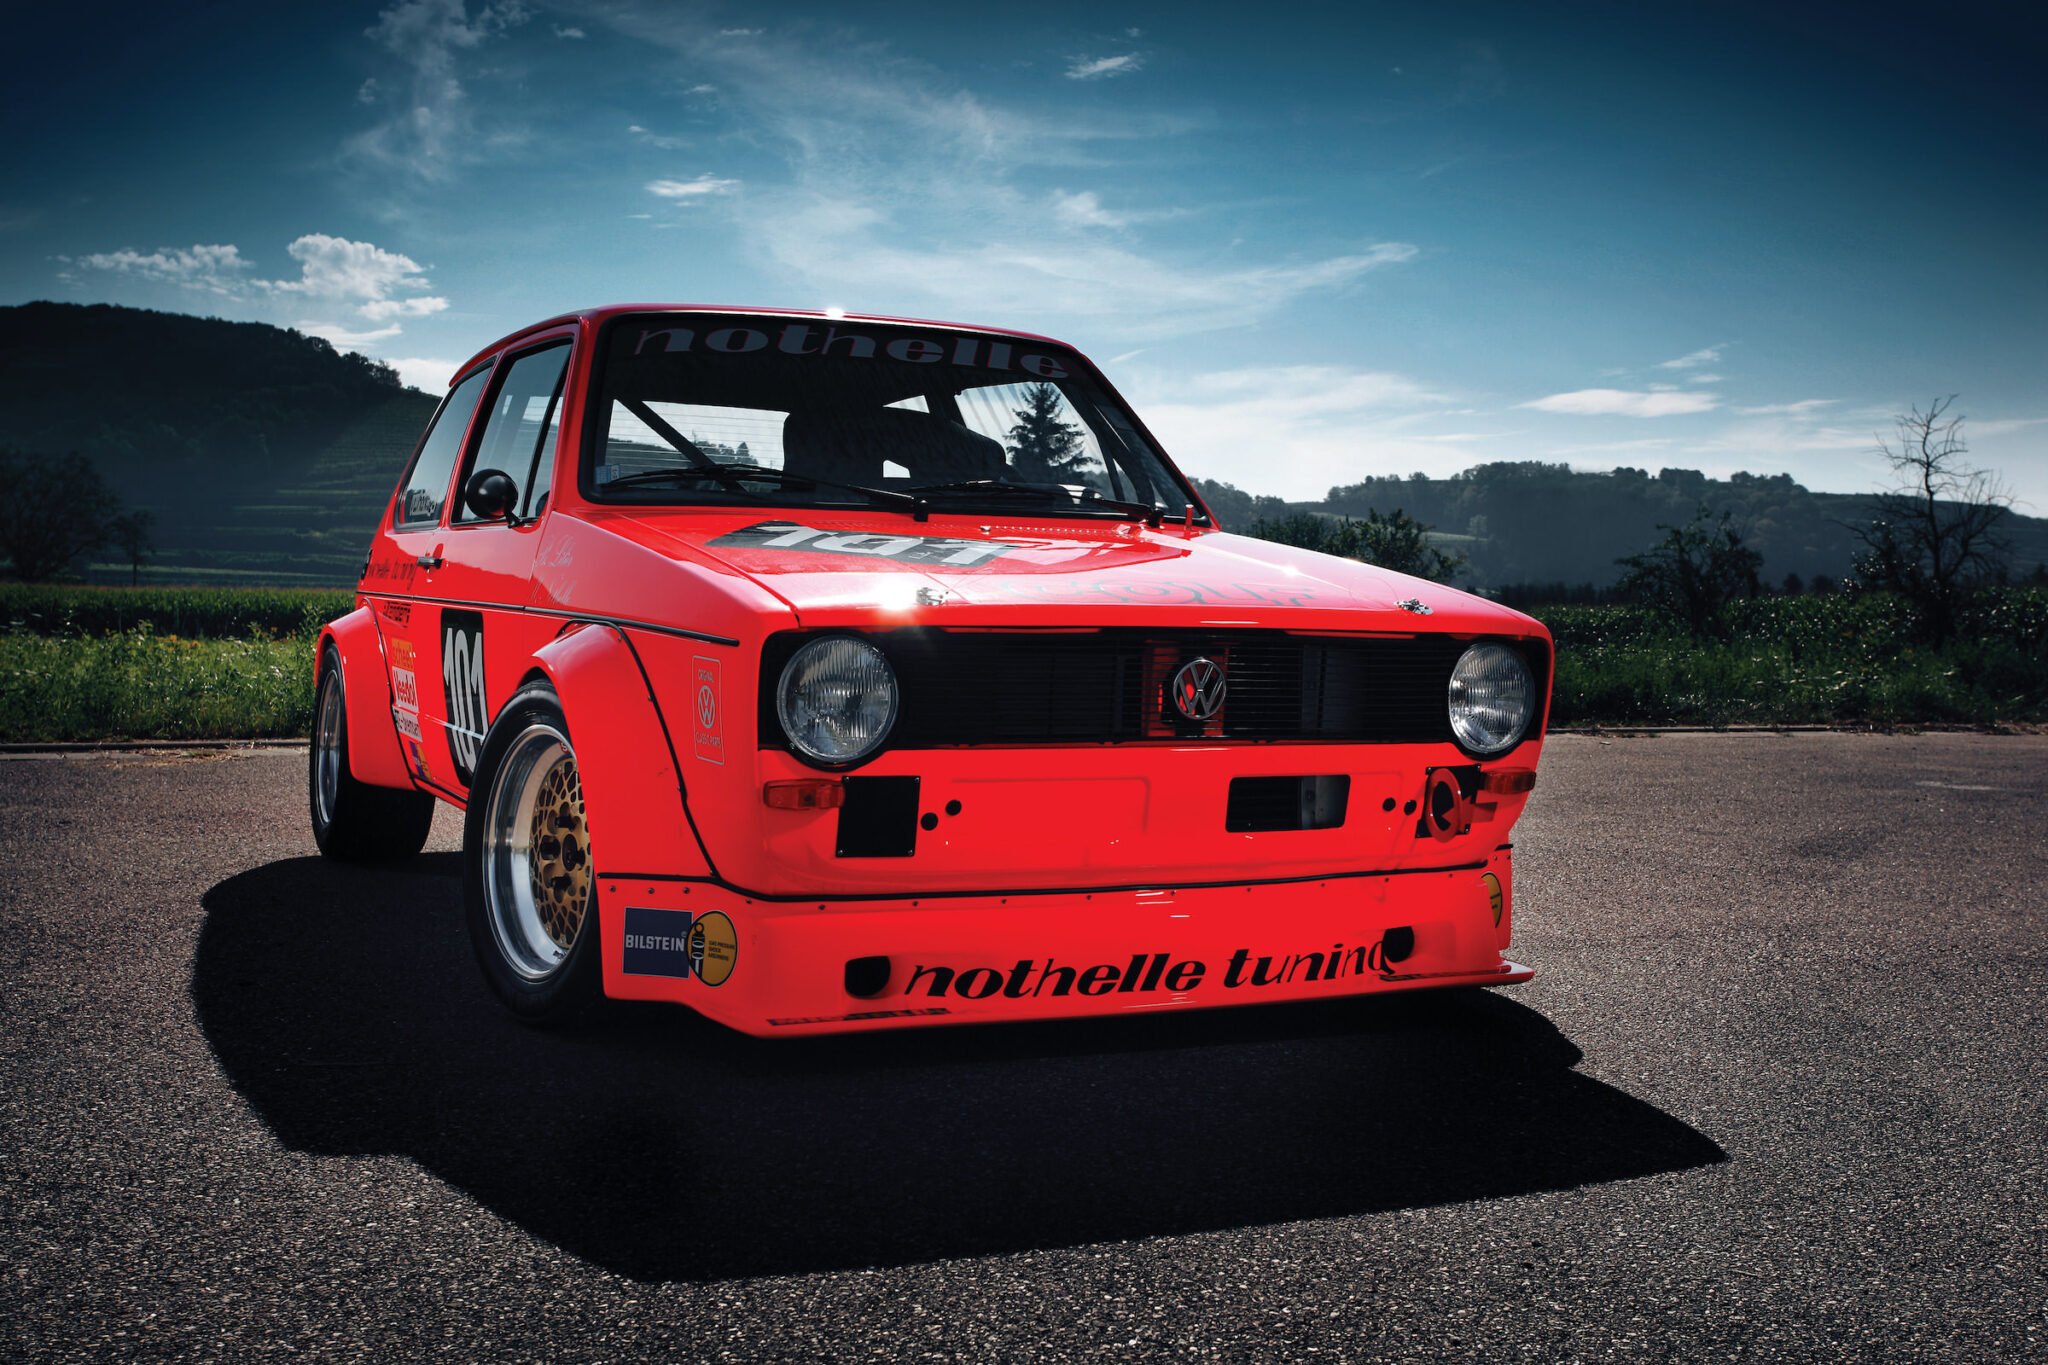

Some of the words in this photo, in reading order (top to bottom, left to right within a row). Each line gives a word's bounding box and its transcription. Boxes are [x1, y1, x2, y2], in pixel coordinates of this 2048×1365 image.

[634, 323, 1069, 380] nothelle
[756, 526, 1006, 565] 101
[443, 627, 489, 777] 101
[625, 934, 685, 951] BILSTEIN
[903, 953, 1206, 999] nothelle
[1223, 941, 1395, 989] tuning
